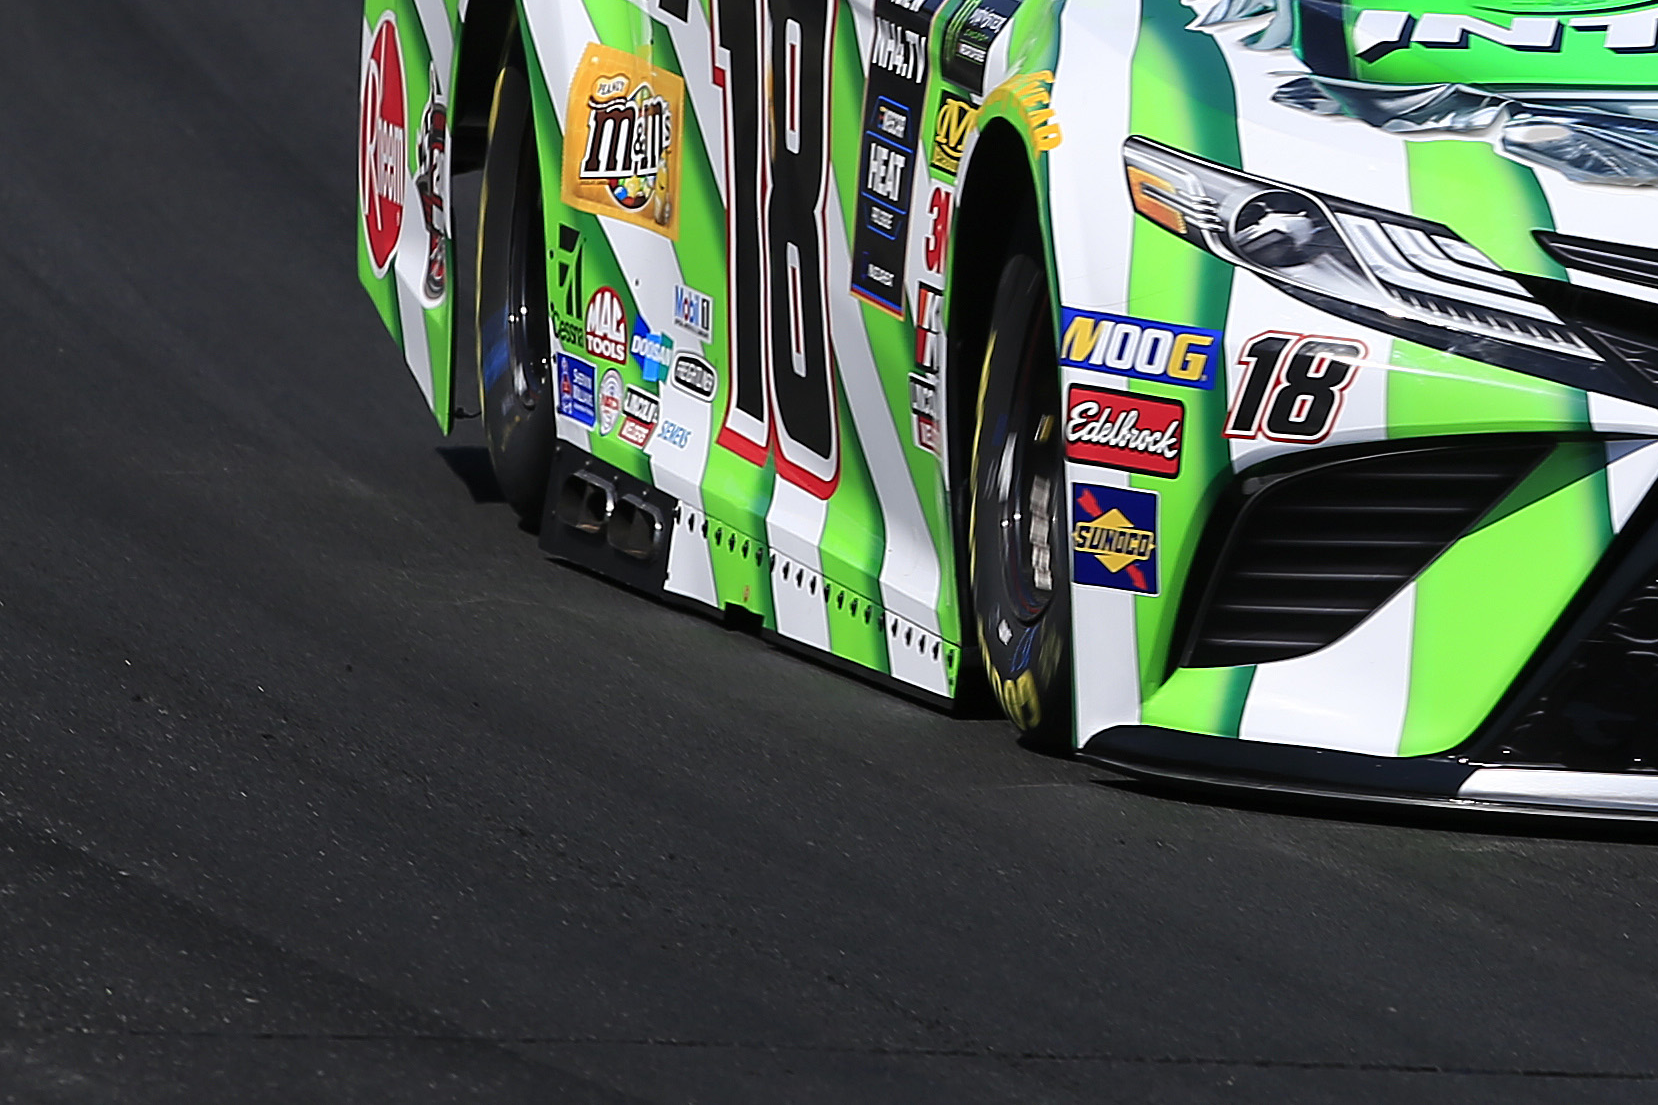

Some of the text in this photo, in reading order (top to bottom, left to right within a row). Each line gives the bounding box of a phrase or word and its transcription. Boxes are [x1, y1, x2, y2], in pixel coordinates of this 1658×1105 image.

[867, 143, 906, 202] HEAT
[586, 291, 626, 343] MAC
[586, 336, 626, 361] TOOLS
[1061, 315, 1214, 381] MOOG
[1225, 332, 1366, 443] 18
[1067, 400, 1180, 459] Edelbrock
[1074, 523, 1154, 560] SUNOCO
